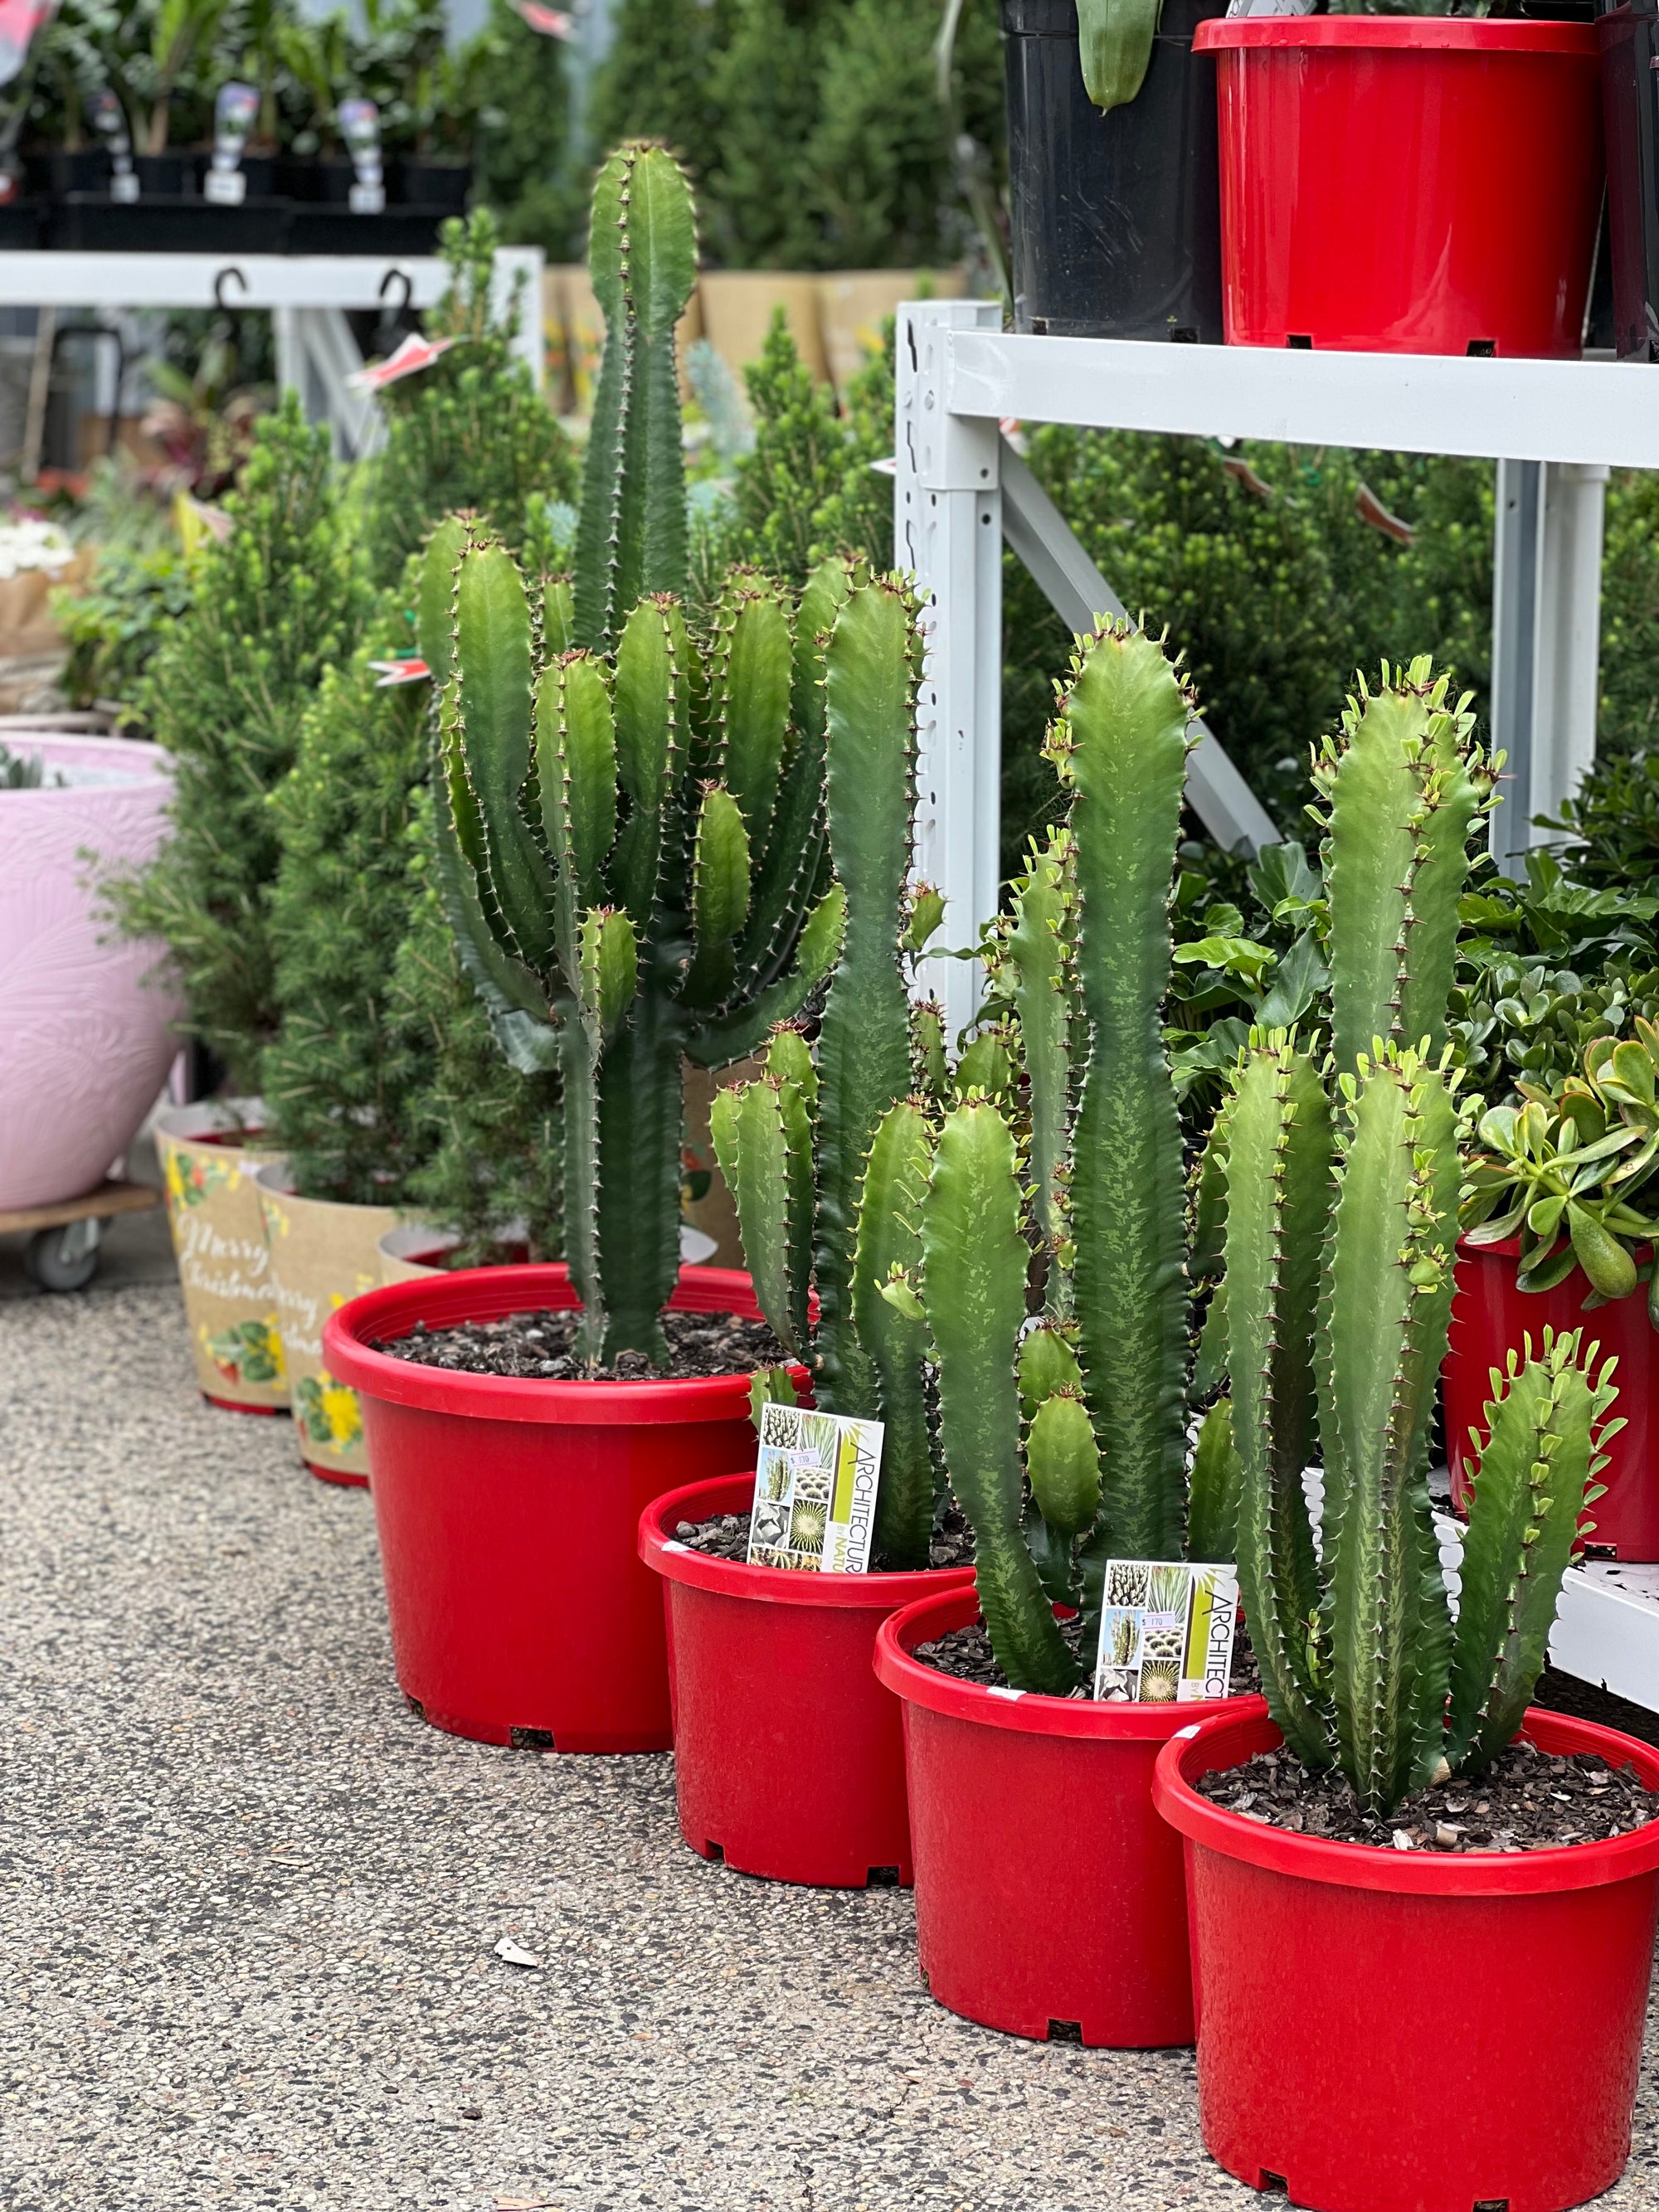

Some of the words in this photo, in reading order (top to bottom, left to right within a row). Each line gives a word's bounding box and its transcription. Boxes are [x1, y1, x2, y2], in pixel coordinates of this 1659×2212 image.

[845, 1441, 877, 1574] ARCHITECTUR
[1151, 1617, 1163, 1626] 170
[1190, 1682, 1199, 1693] BY
